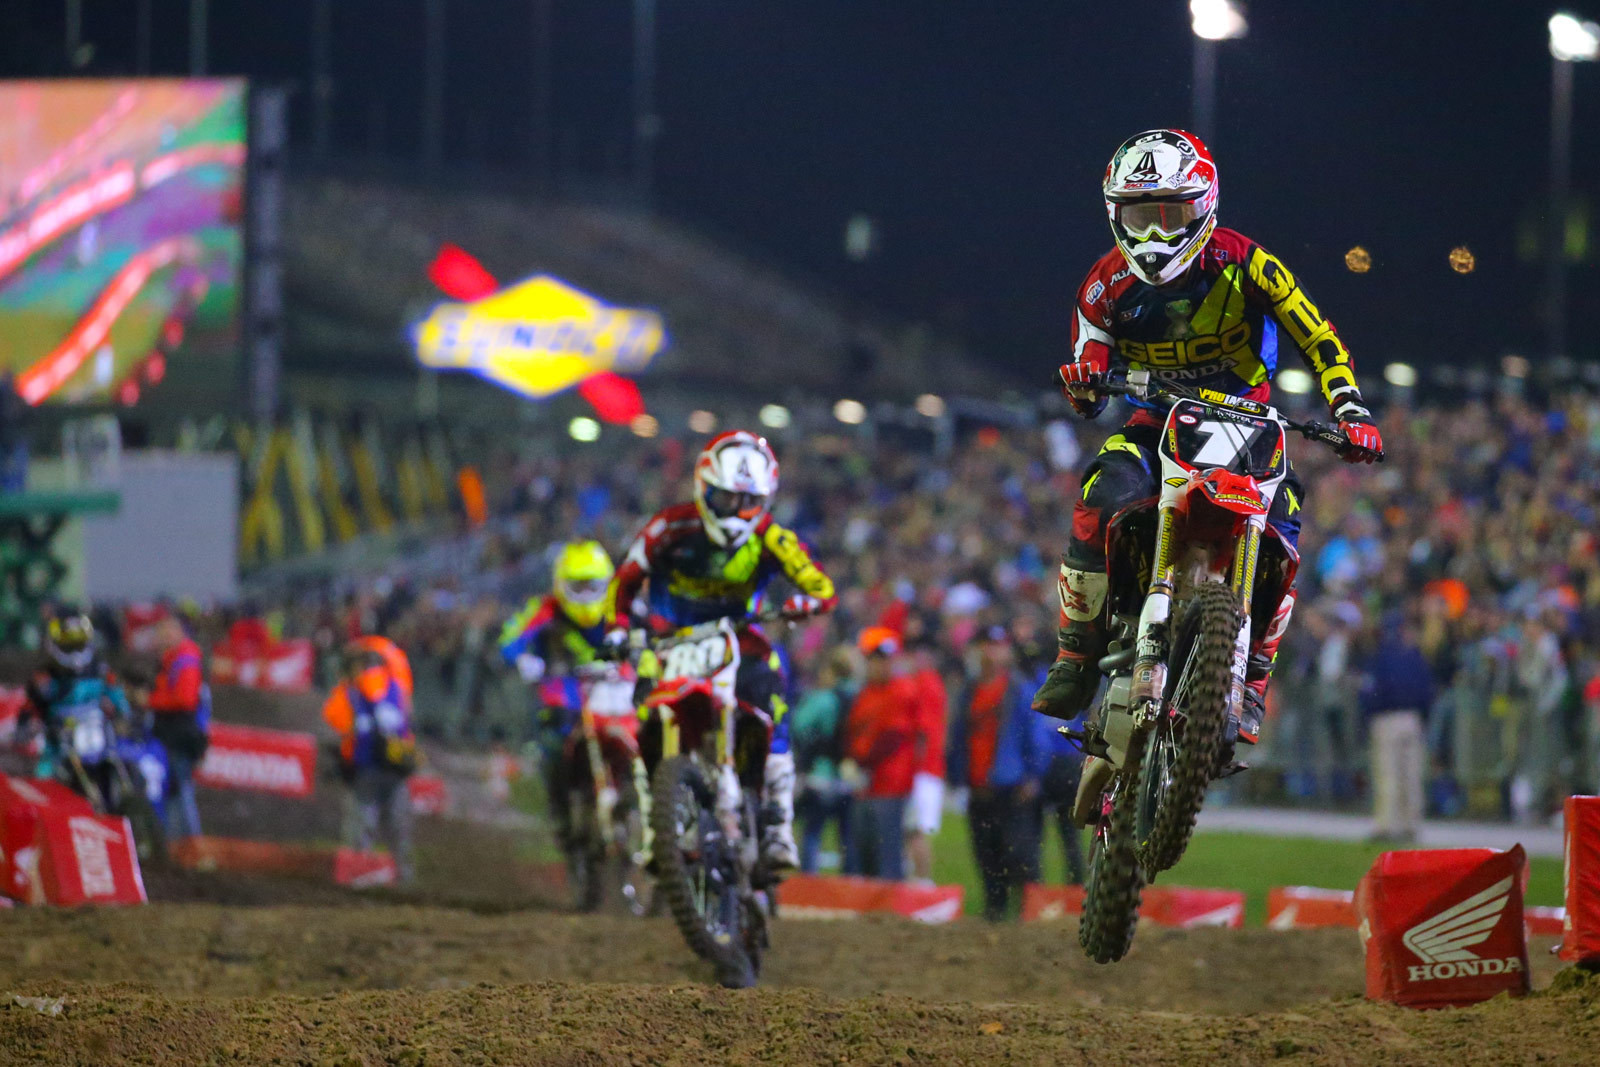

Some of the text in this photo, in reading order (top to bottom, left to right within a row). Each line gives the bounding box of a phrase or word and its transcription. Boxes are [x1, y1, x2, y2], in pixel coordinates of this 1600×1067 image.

[1180, 222, 1214, 265] GEICO
[1117, 321, 1252, 366] GEICO
[1214, 493, 1265, 509] GEICO
[1218, 498, 1261, 511] HONDA
[1407, 957, 1525, 982] HONDA
